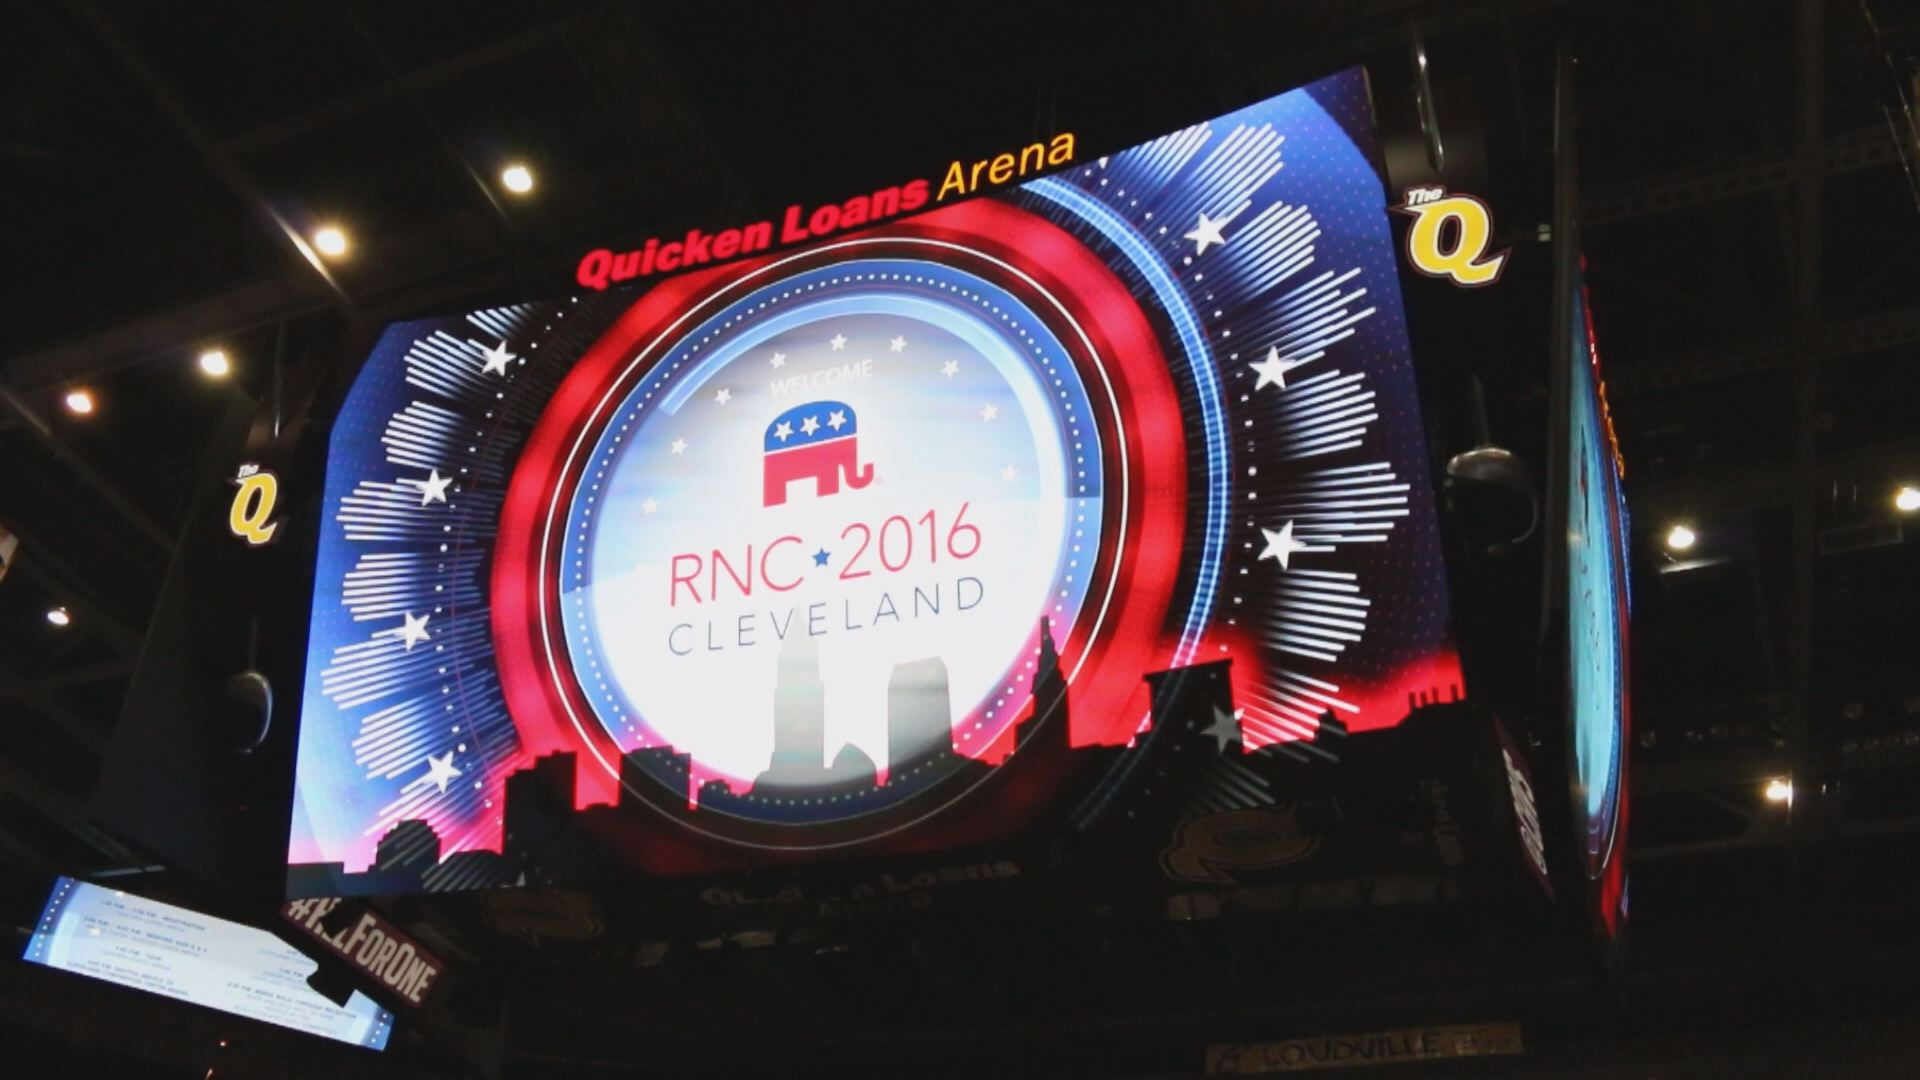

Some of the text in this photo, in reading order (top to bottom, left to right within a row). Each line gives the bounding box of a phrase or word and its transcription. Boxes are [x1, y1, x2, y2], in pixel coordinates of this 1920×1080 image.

[576, 132, 1077, 288] Quicken Loans Arena
[1406, 187, 1444, 207] The
[1404, 197, 1504, 285] Q
[769, 358, 874, 398] WELCOME
[229, 472, 278, 545] Q
[670, 501, 982, 608] RNC 2016
[667, 576, 985, 657] CLEVELAND
